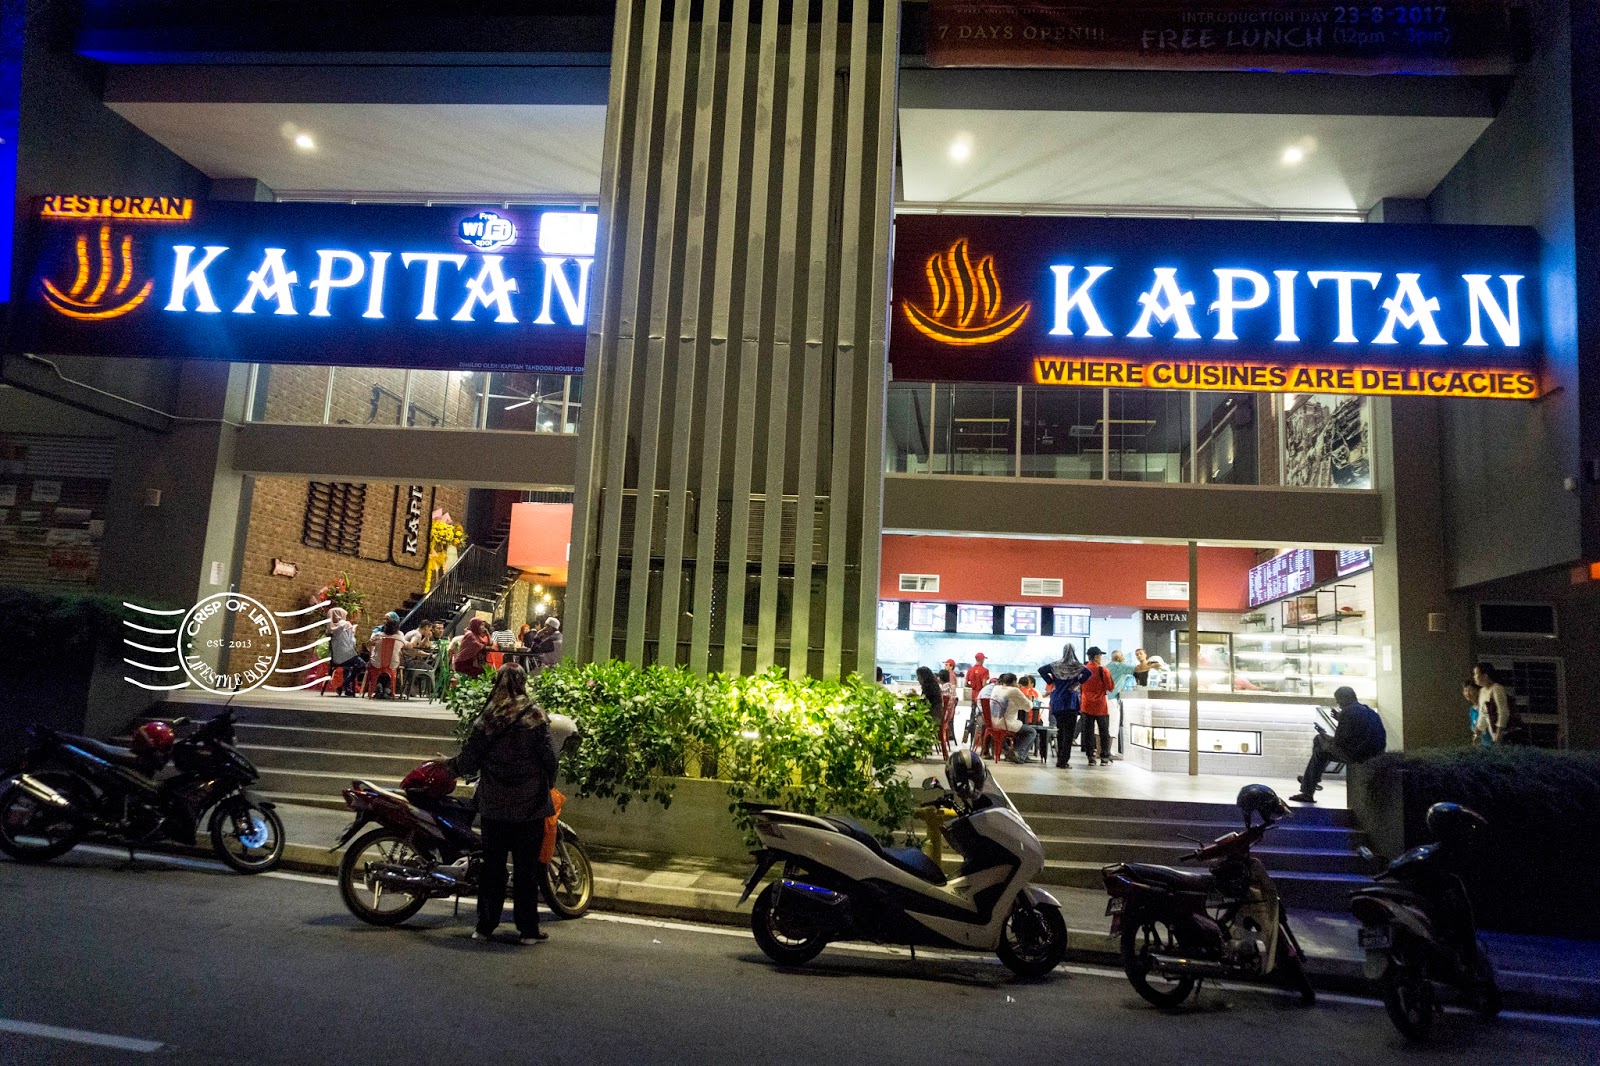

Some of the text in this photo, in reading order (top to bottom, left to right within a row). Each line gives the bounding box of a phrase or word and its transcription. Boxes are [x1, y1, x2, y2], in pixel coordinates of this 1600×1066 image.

[1181, 5, 1448, 25] INTRODUCTION DAY 23-8-2017
[937, 24, 1105, 41] 7 DAYS OPEN!!!
[1140, 27, 1217, 50] FREE
[1226, 26, 1324, 49] LUNCH
[42, 194, 187, 216] RESTORAN
[479, 212, 499, 221] Free
[163, 245, 593, 326] KAPITAN
[1047, 263, 1526, 348] KAPITAN
[1037, 358, 1537, 397] WHERE CUISINES ARE DELICACIES
[1145, 612, 1188, 622] KAPITAN
